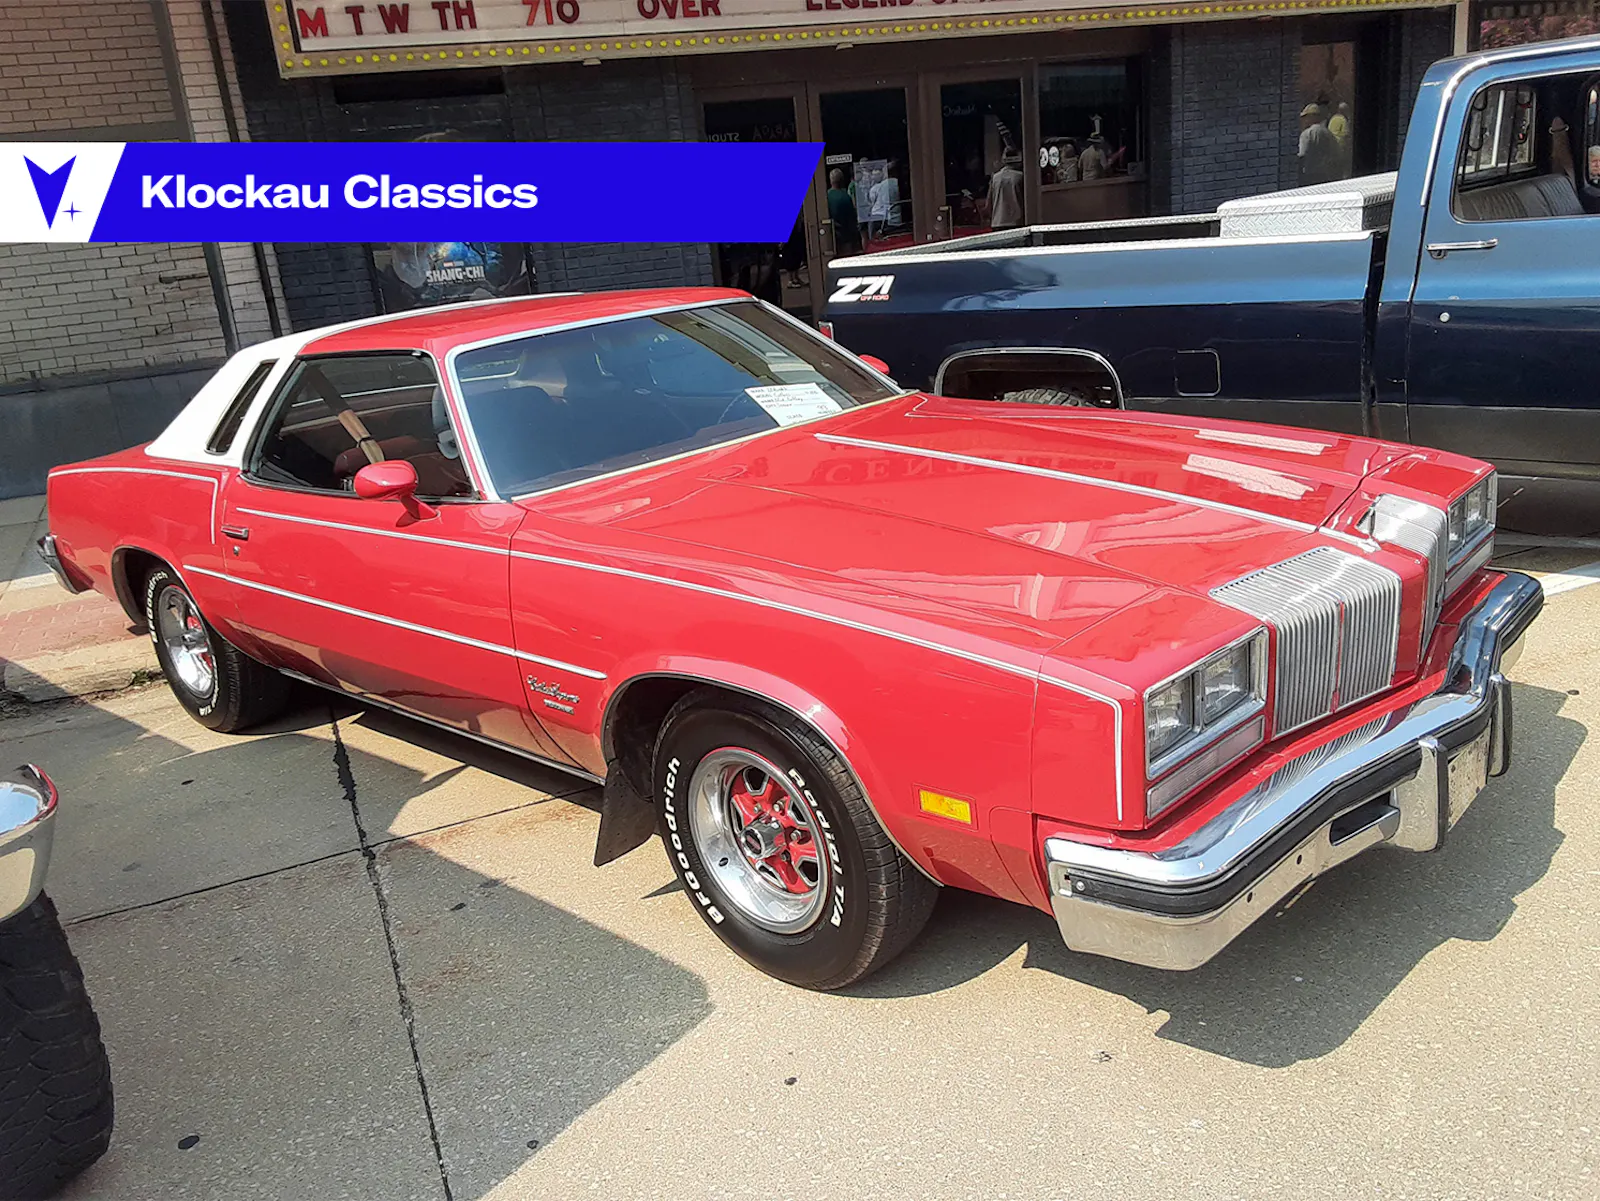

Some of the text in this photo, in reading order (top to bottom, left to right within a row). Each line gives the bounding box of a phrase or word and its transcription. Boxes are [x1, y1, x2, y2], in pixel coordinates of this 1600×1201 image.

[297, 7, 329, 38] M
[345, 5, 365, 36] T
[378, 3, 409, 34] W
[432, 0, 477, 31] TH
[638, 0, 721, 20] OVER
[426, 265, 485, 283] SHANG-CHI
[828, 275, 895, 303] Z71
[663, 757, 725, 925] BFGoodrich
[788, 768, 845, 927] Radial T/A
